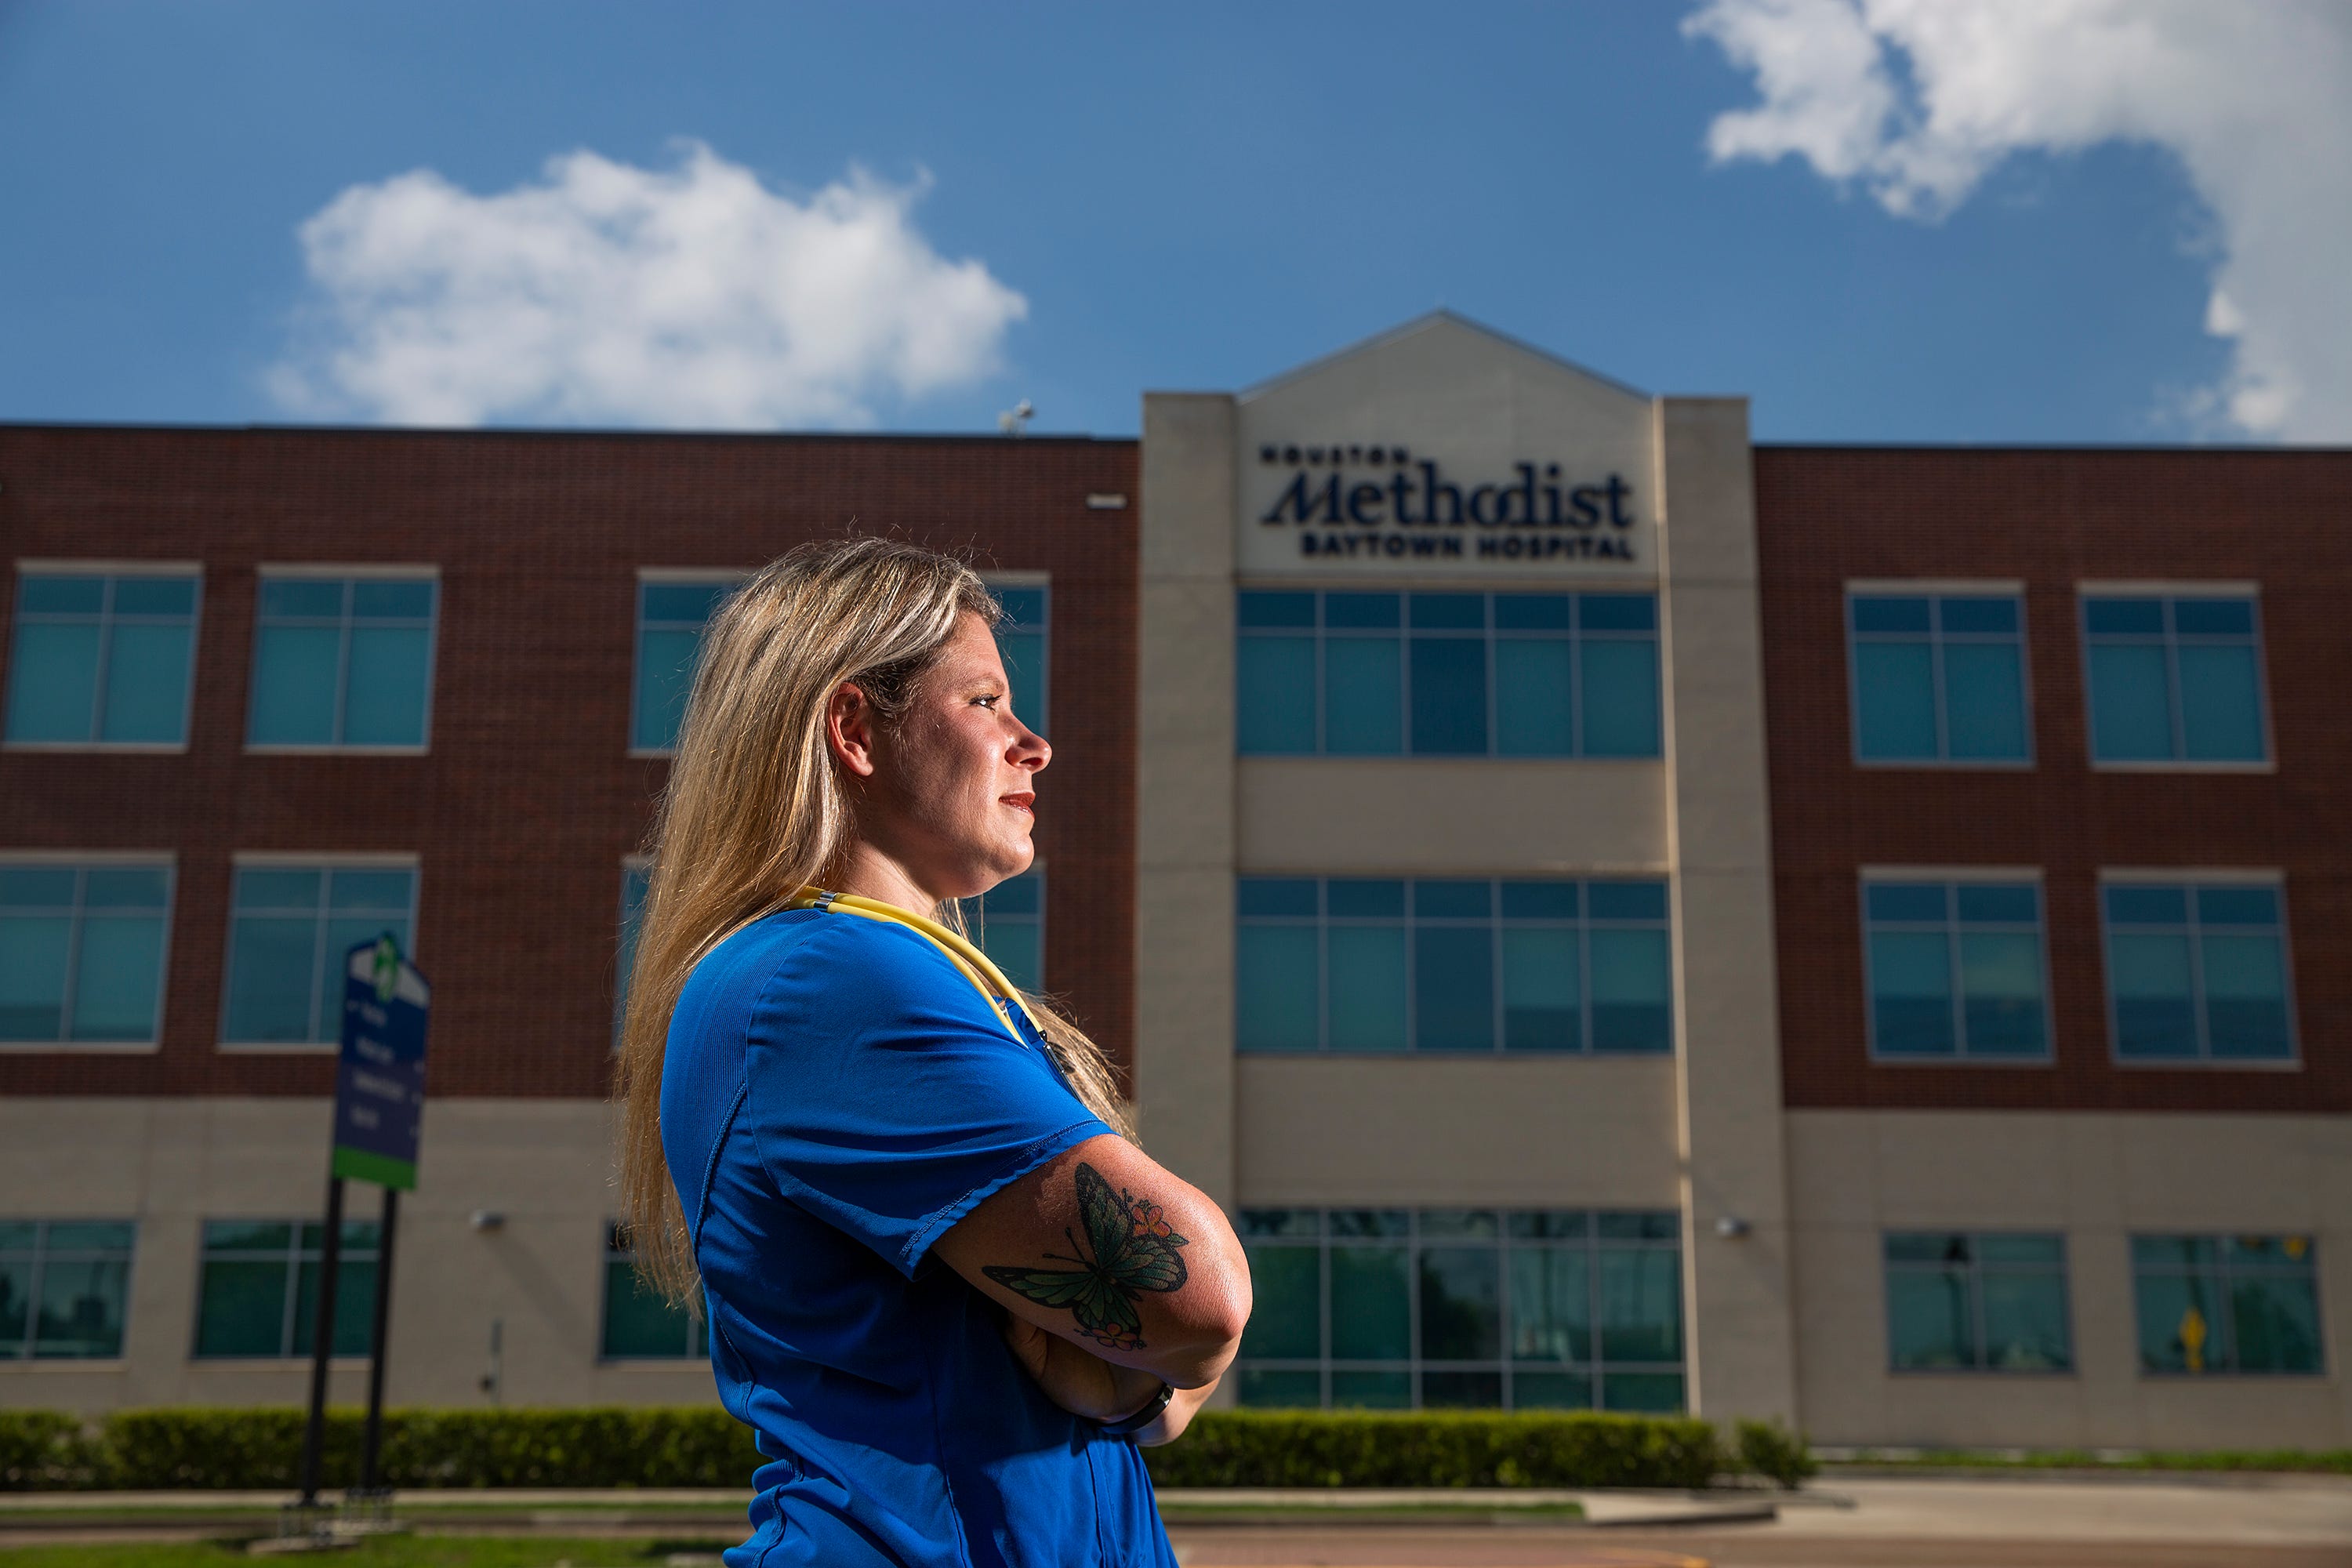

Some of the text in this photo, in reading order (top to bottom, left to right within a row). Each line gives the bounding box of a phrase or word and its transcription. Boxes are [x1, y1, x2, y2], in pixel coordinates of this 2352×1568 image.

[1260, 445, 1409, 466] HOUSTON
[1261, 459, 1634, 527] Methodist
[1301, 533, 1635, 562] BAYTOWN HOSPITAL
